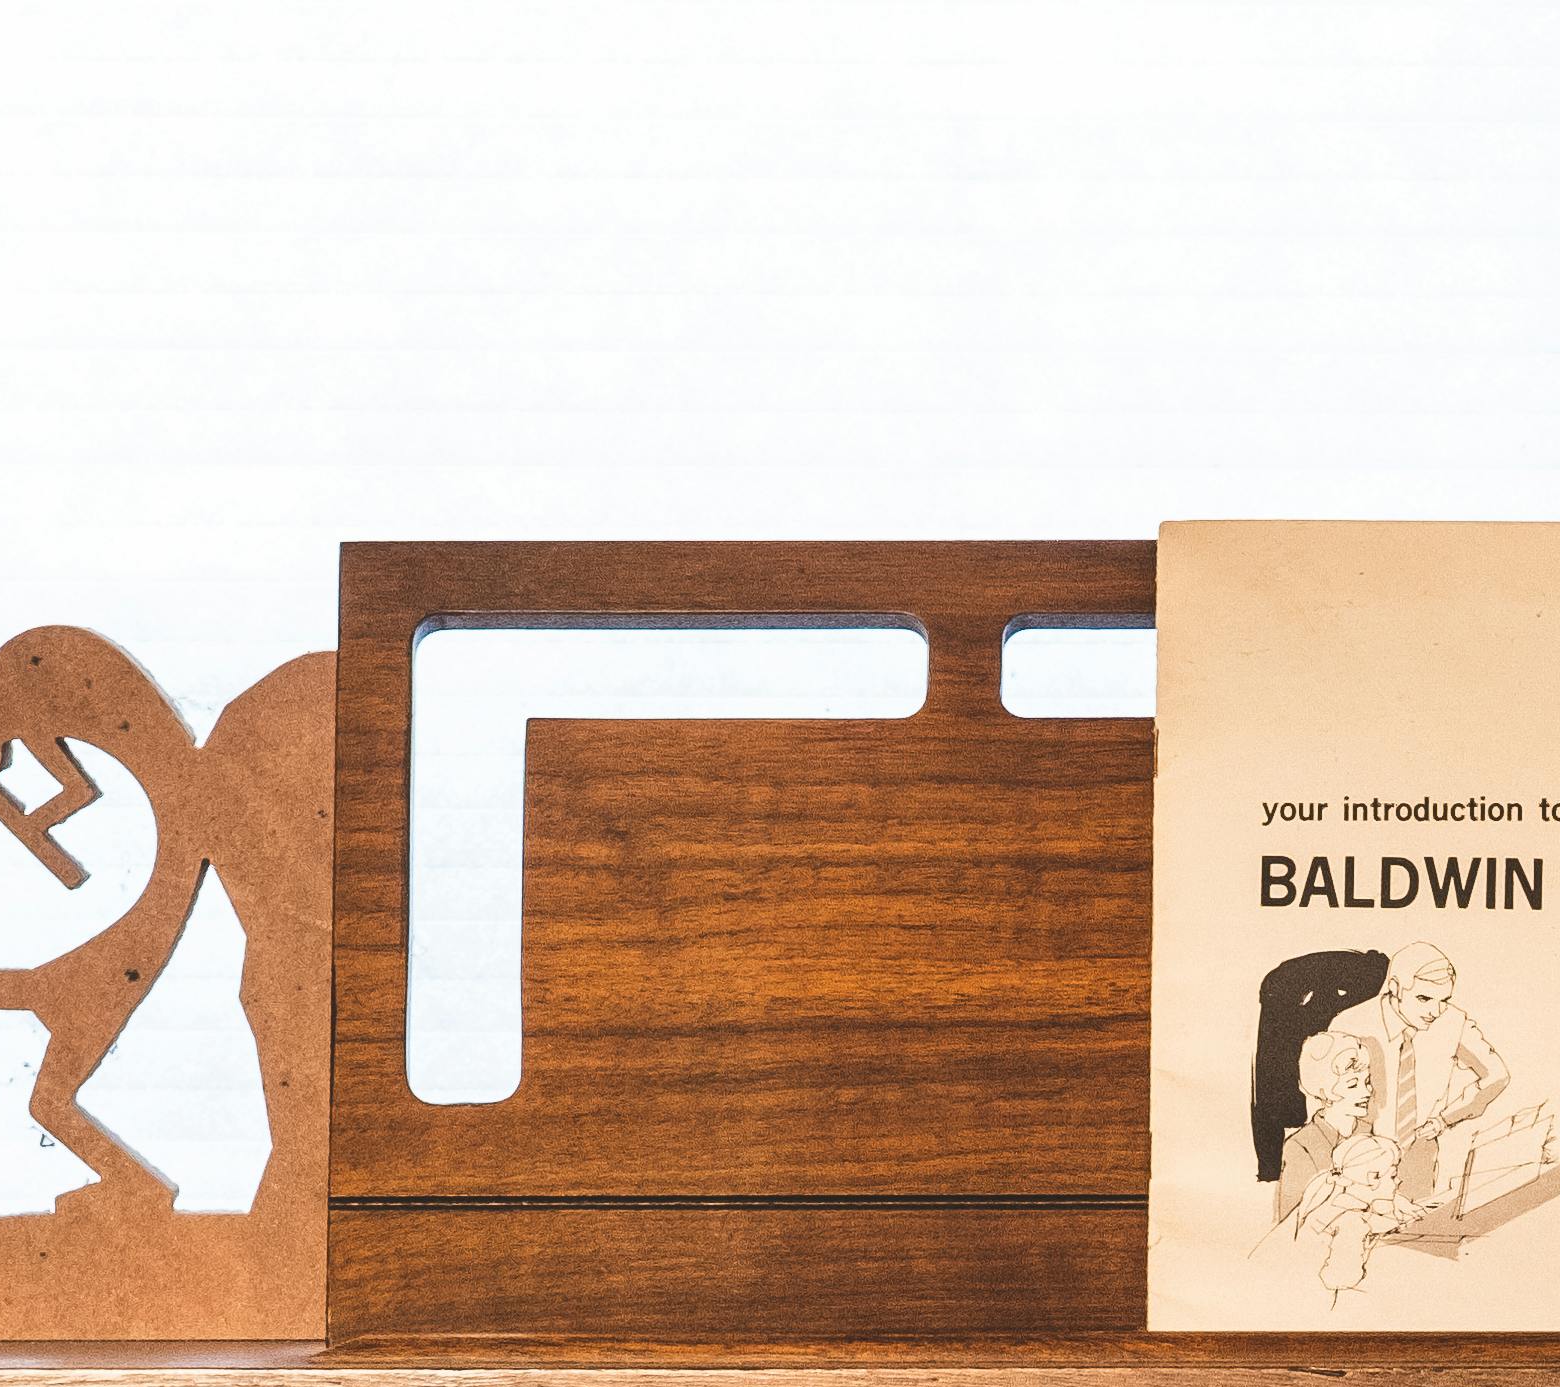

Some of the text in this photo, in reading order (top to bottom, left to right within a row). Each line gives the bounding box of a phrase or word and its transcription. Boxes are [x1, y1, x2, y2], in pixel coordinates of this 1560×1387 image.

[1262, 799, 1329, 827] your
[1343, 796, 1523, 822] introduction
[1260, 855, 1544, 911] BALDWIN
